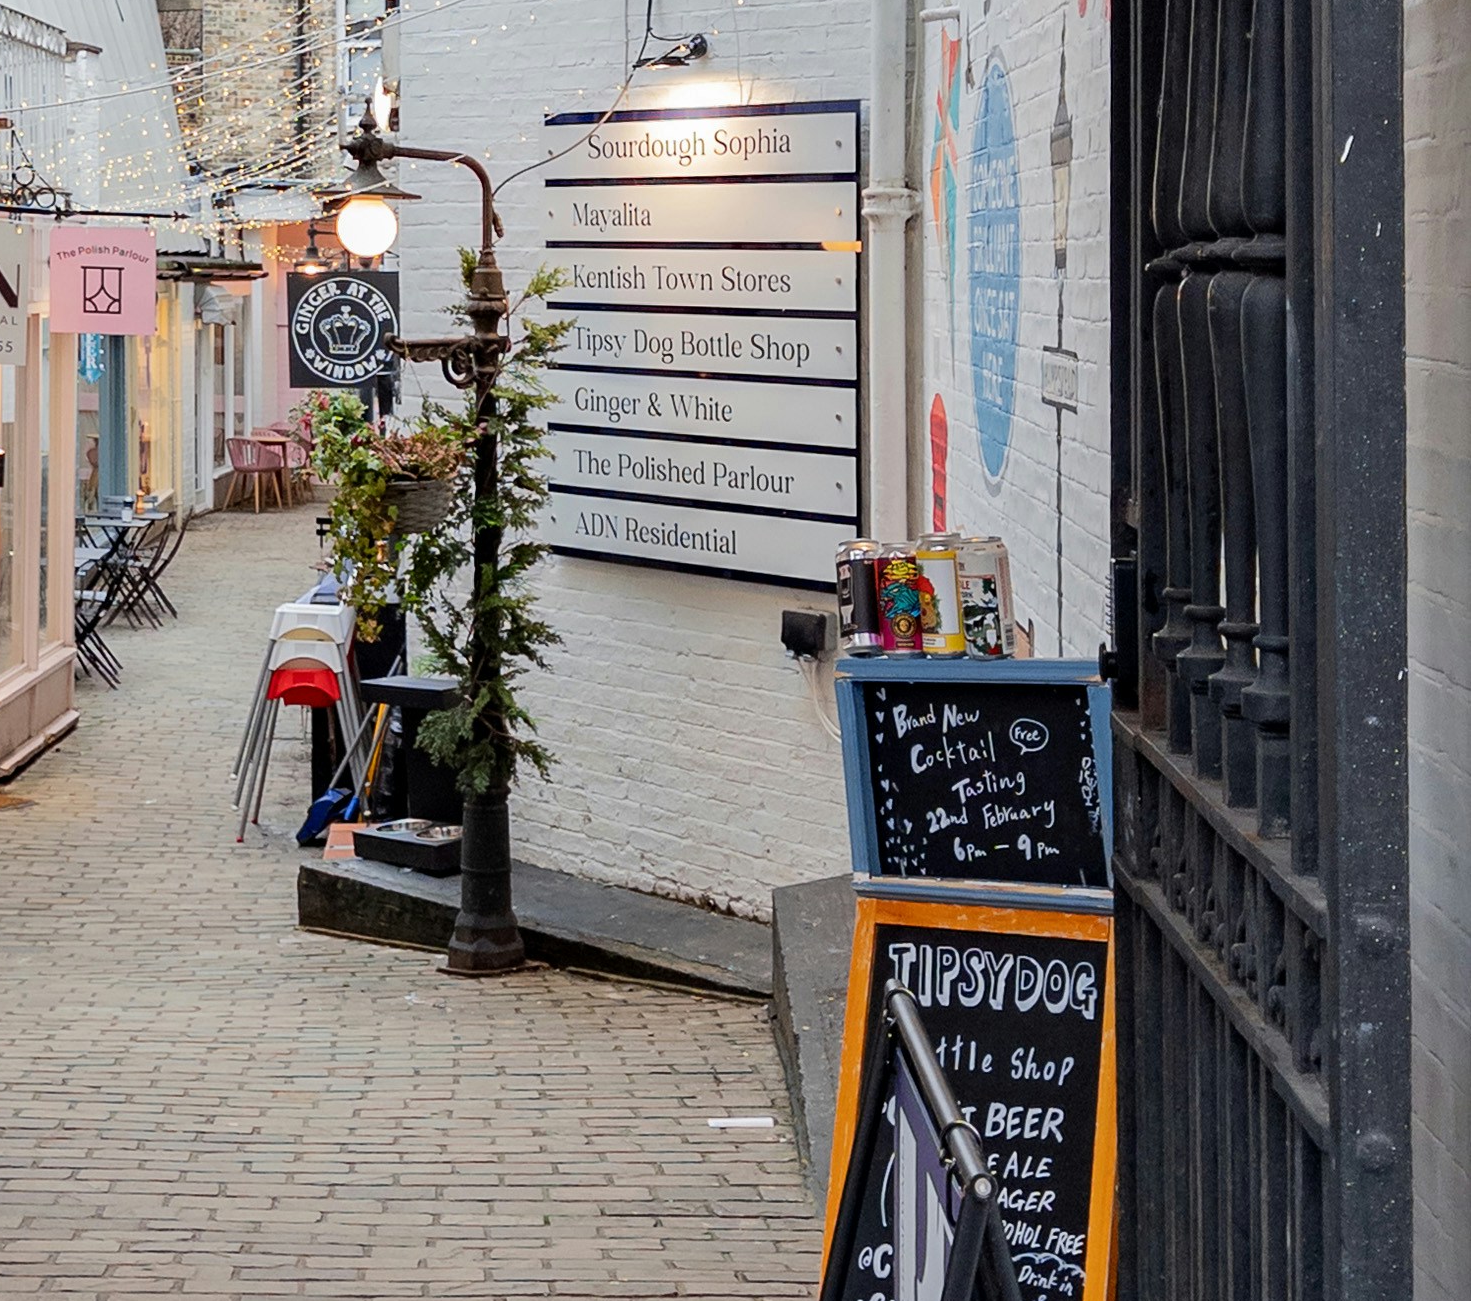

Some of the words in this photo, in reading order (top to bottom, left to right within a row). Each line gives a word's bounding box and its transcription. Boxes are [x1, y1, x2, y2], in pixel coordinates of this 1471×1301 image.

[587, 131, 706, 167] Sourdough
[713, 128, 792, 161] Sophia
[572, 201, 652, 233] Mayalita
[56, 249, 76, 261] The
[78, 245, 110, 256] Polish
[112, 246, 150, 264] Parlour
[572, 263, 646, 290] Kentish
[652, 264, 713, 291] Town
[721, 265, 792, 293] Stores
[295, 282, 341, 335] GINGER
[346, 282, 368, 299] AT
[369, 293, 391, 322] THE
[572, 326, 627, 359] Tipsy
[633, 329, 674, 365] Dog
[680, 330, 743, 359] Bottle
[750, 333, 811, 368] Shop
[313, 354, 377, 379] WINDOW
[574, 386, 641, 423] Ginger
[647, 392, 662, 417] &
[670, 393, 733, 422] White
[573, 449, 611, 476] The
[618, 453, 706, 485] Polished
[713, 461, 795, 494] Parlour
[575, 511, 618, 539] ADN
[625, 516, 737, 555] Residential
[892, 703, 937, 739] Brand
[942, 703, 980, 734] New
[1014, 727, 1041, 741] Free
[910, 731, 996, 774] Cocktail
[951, 769, 1026, 804] Tasting
[926, 806, 969, 834] 22nd
[982, 800, 1055, 829] February
[935, 1034, 993, 1074] ttle
[1010, 1047, 1076, 1086] Shop
[984, 1101, 1065, 1144] BEER
[1003, 1150, 1054, 1179] ALE
[997, 1187, 1057, 1213] AGER
[1045, 1227, 1087, 1255] FREE
[1018, 1265, 1058, 1290] Drink
[1059, 1275, 1073, 1296] in
